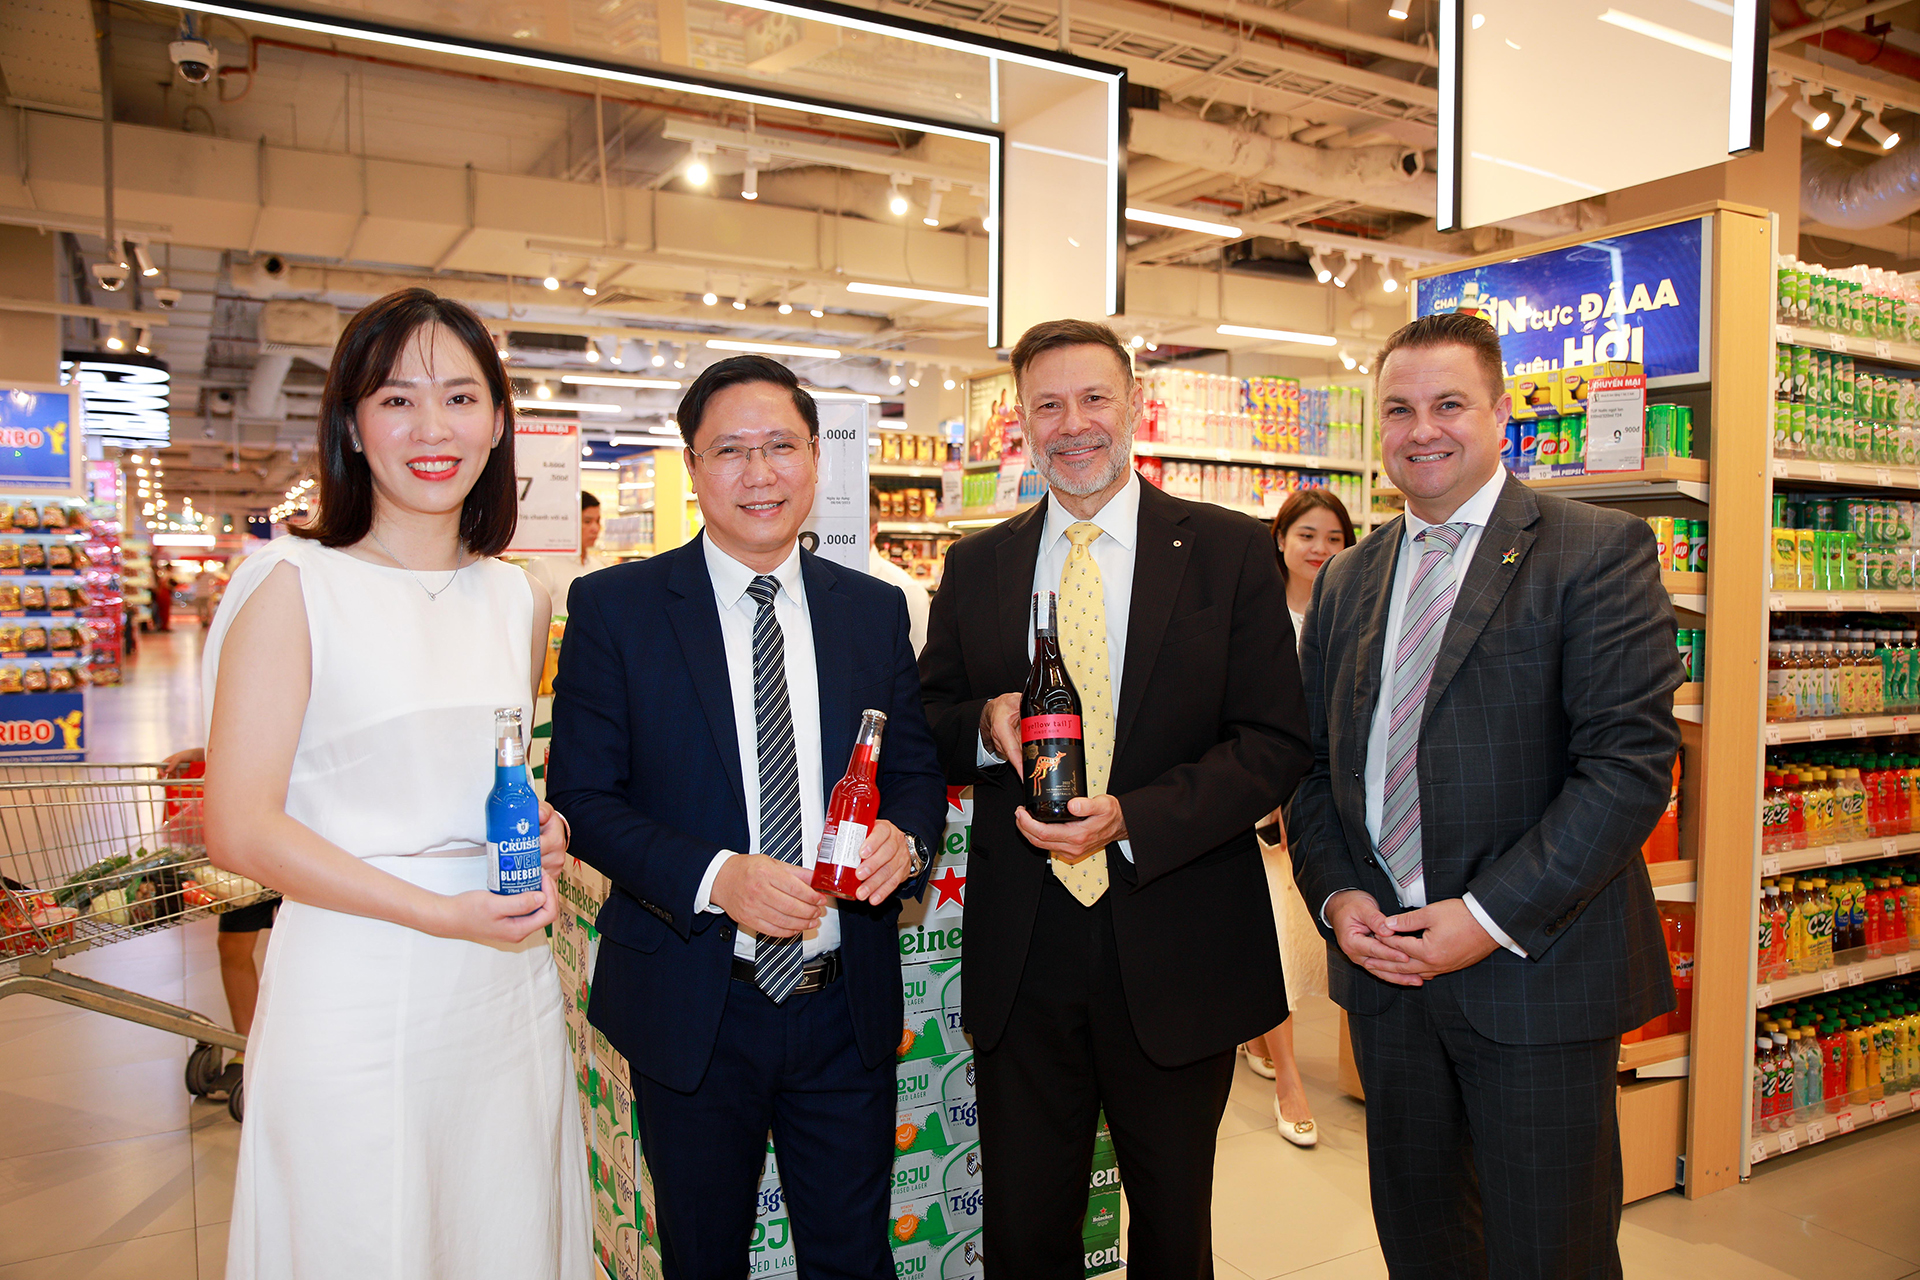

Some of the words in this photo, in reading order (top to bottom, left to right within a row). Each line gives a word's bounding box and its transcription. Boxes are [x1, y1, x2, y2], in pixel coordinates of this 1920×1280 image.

[1433, 297, 1458, 311] CHAI
[1476, 292, 1527, 337] ỚN
[1563, 319, 1645, 370] HỜI
[1625, 377, 1641, 388] MẠI
[823, 429, 856, 440] .000đ
[1613, 429, 1622, 444] 9
[823, 534, 856, 545] .000đ
[1773, 806, 1790, 824] C2
[557, 871, 601, 919] Heineken
[899, 925, 963, 955] eine
[904, 980, 927, 999] JU
[907, 998, 925, 1006] LAGER
[896, 1073, 929, 1095] OJU
[1778, 1070, 1794, 1092] C2
[910, 1090, 927, 1101] LAGER
[948, 1100, 978, 1127] Tig
[616, 1171, 633, 1203] Tiger
[891, 1185, 910, 1195] FUSED
[911, 1182, 928, 1192] LAGER
[757, 1186, 786, 1213] Tig
[950, 1188, 984, 1216] Tige
[749, 1216, 789, 1254] OJ
[774, 1254, 795, 1269] LAG
[895, 1255, 927, 1278] OJU
